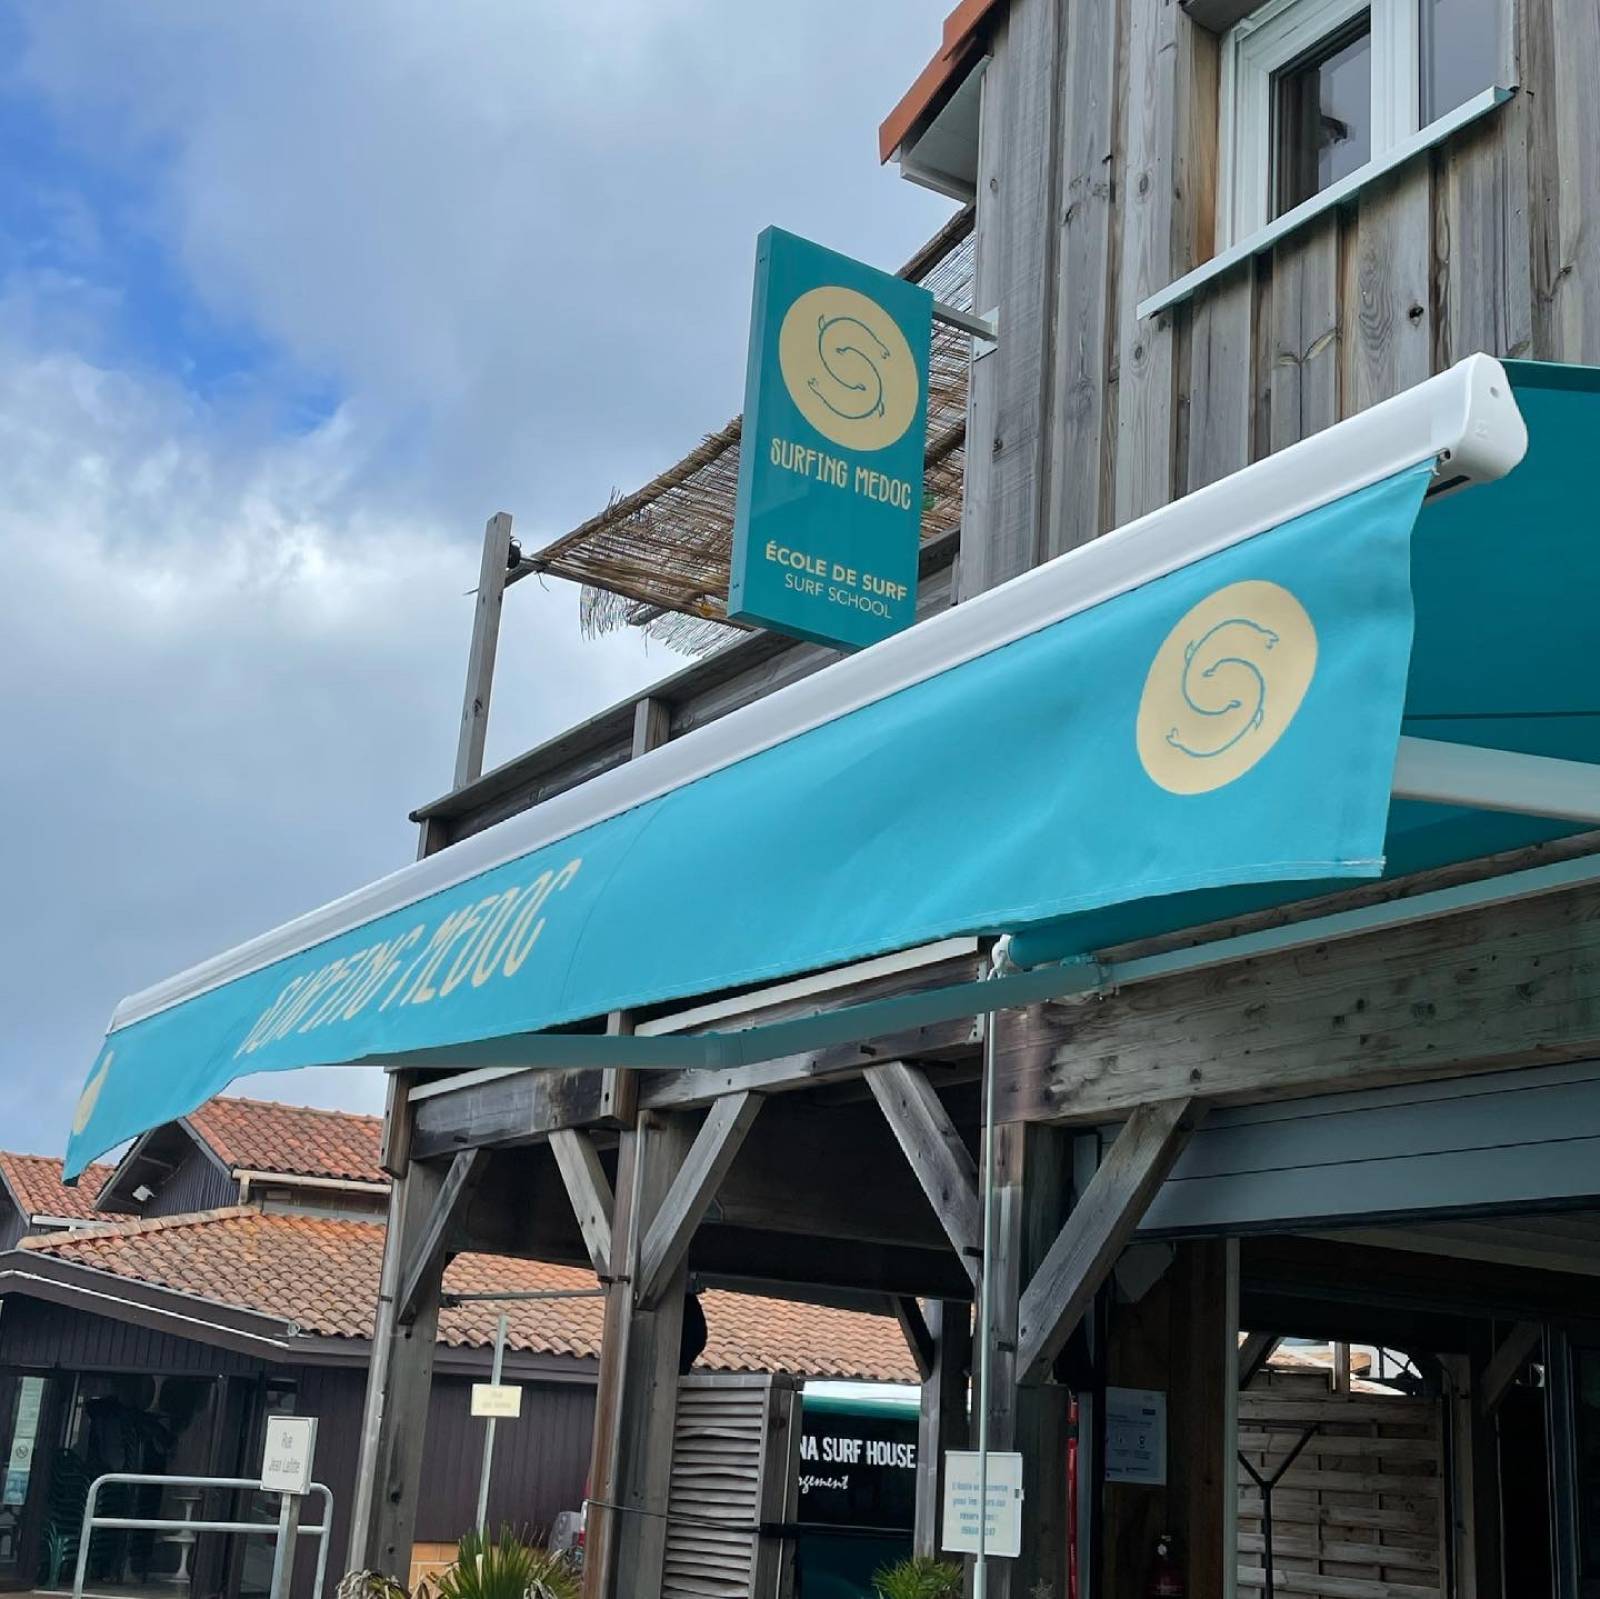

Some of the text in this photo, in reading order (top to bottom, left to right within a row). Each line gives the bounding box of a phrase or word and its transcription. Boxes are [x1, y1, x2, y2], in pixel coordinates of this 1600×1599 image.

[770, 438, 912, 511] SURFING MEDOC
[765, 540, 908, 602] ÉCOLE DE SURF
[784, 573, 893, 620] SURF SCHOOL
[378, 858, 583, 1013] MEDOC
[822, 1436, 863, 1464] SURF
[865, 1440, 917, 1469] HOUSE
